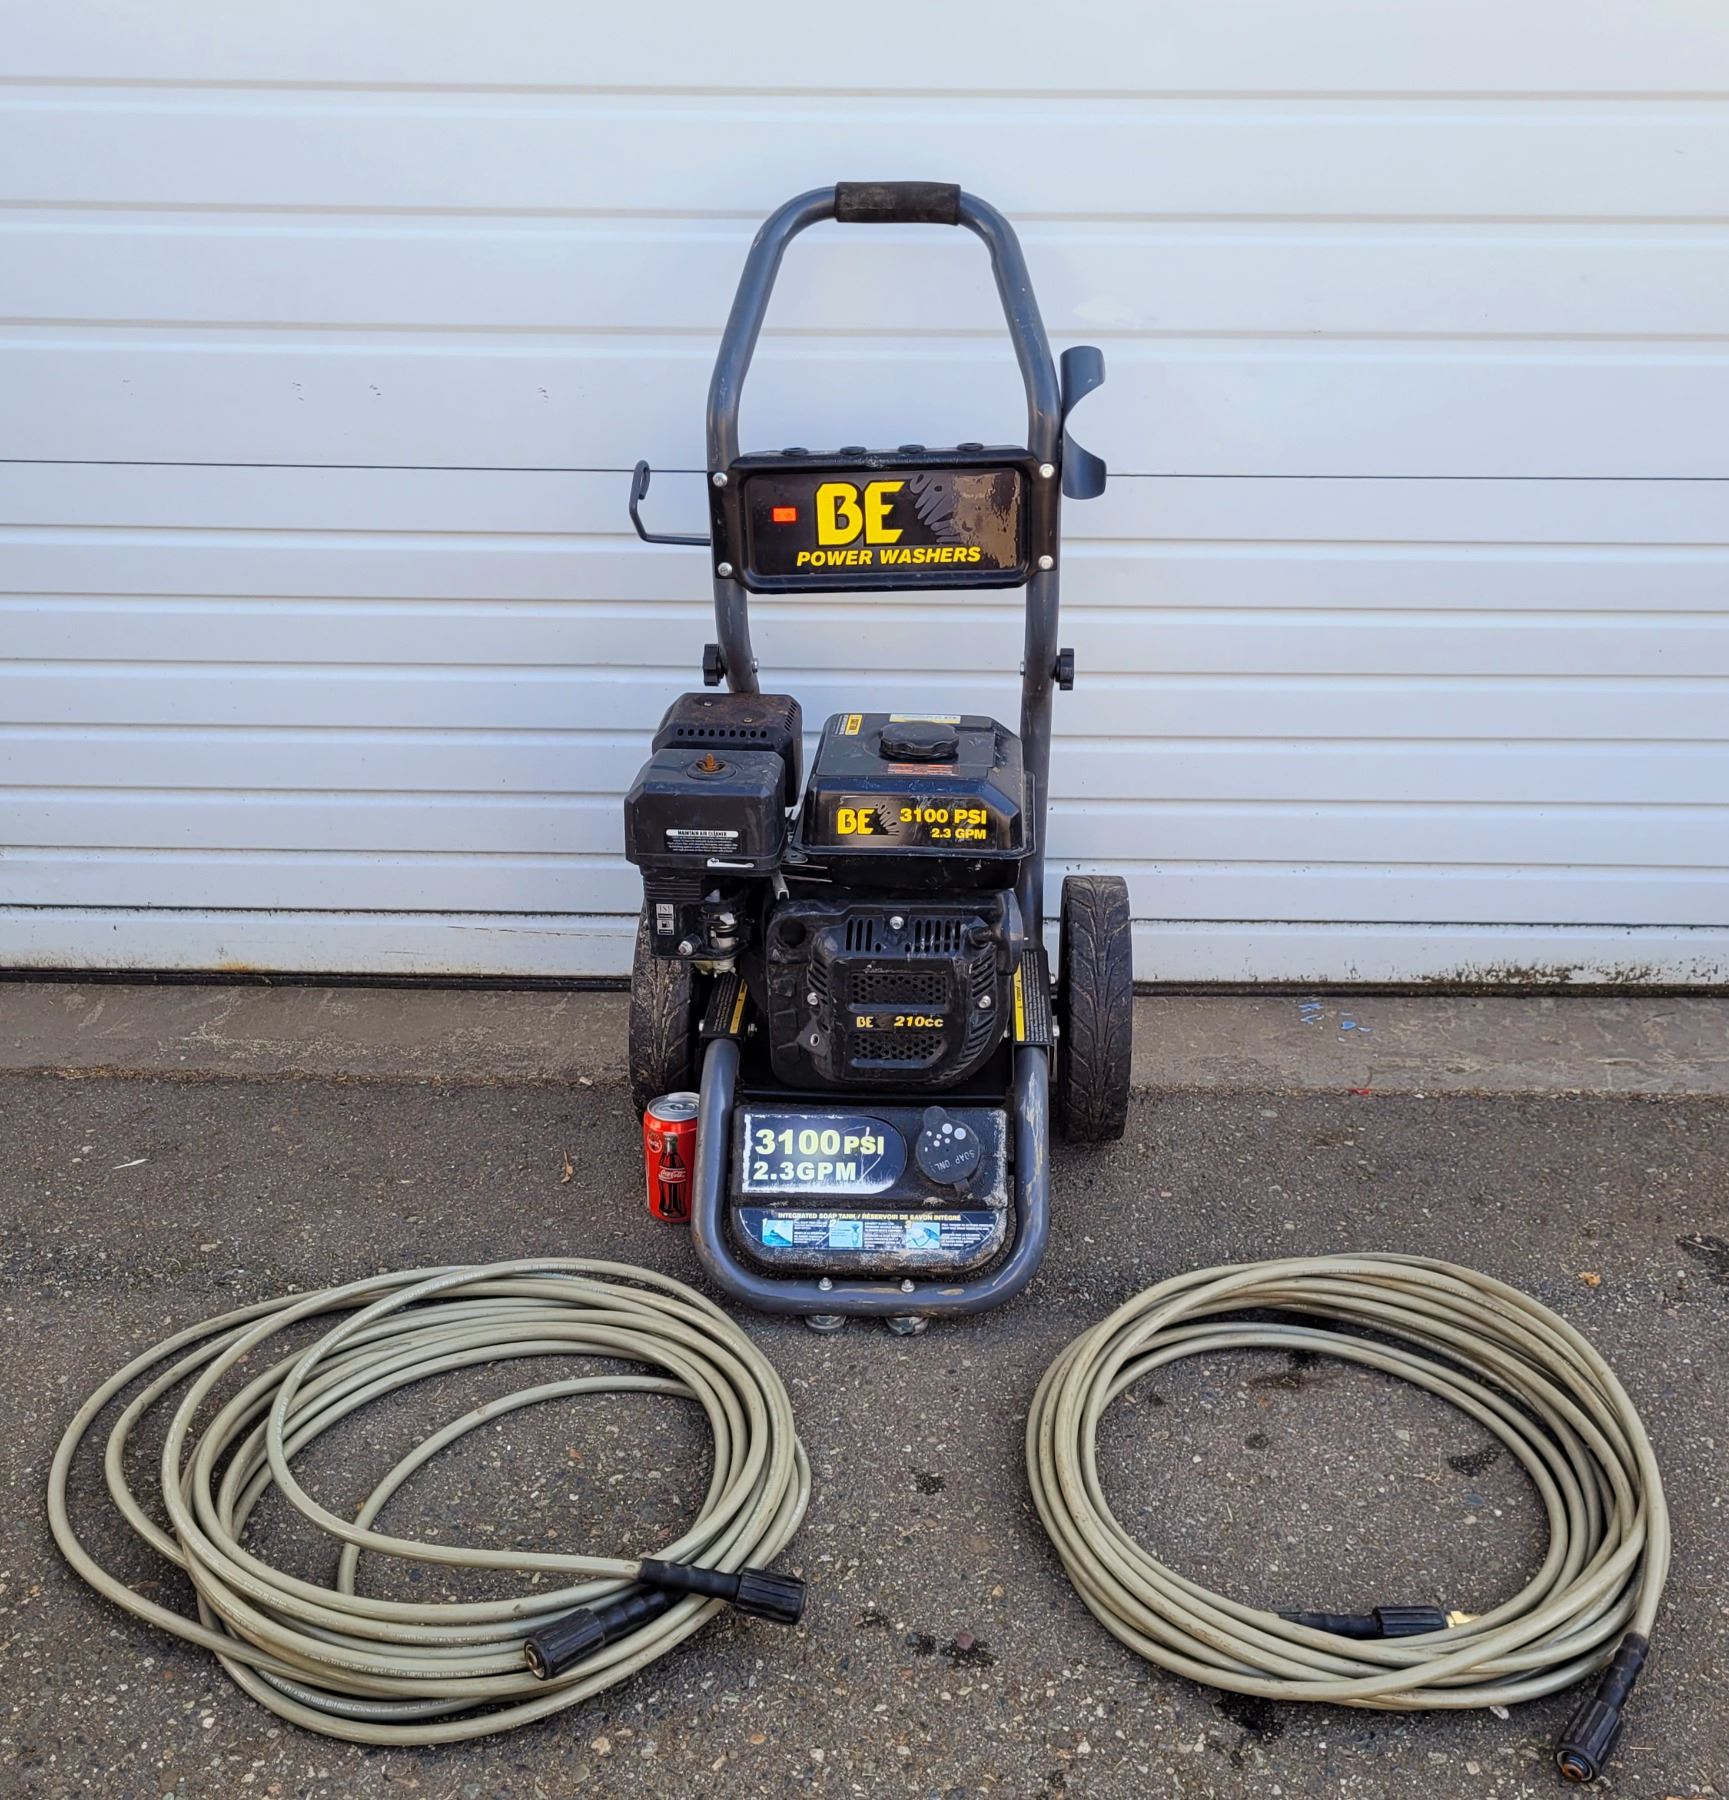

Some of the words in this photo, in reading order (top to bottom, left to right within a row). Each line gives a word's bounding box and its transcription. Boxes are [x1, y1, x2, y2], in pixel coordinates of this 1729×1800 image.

[816, 481, 905, 546] BE
[797, 550, 872, 567] POWER
[881, 546, 981, 565] WASHERS
[836, 807, 875, 836] BE
[900, 808, 949, 824] 3100
[954, 808, 987, 825] PSI
[931, 827, 951, 839] 2.3
[955, 828, 987, 840] GPM
[856, 1016, 874, 1028] BE
[894, 1015, 944, 1028] 210cc
[954, 1149, 975, 1165] SOAP
[753, 1161, 857, 1181] 2.3GPM
